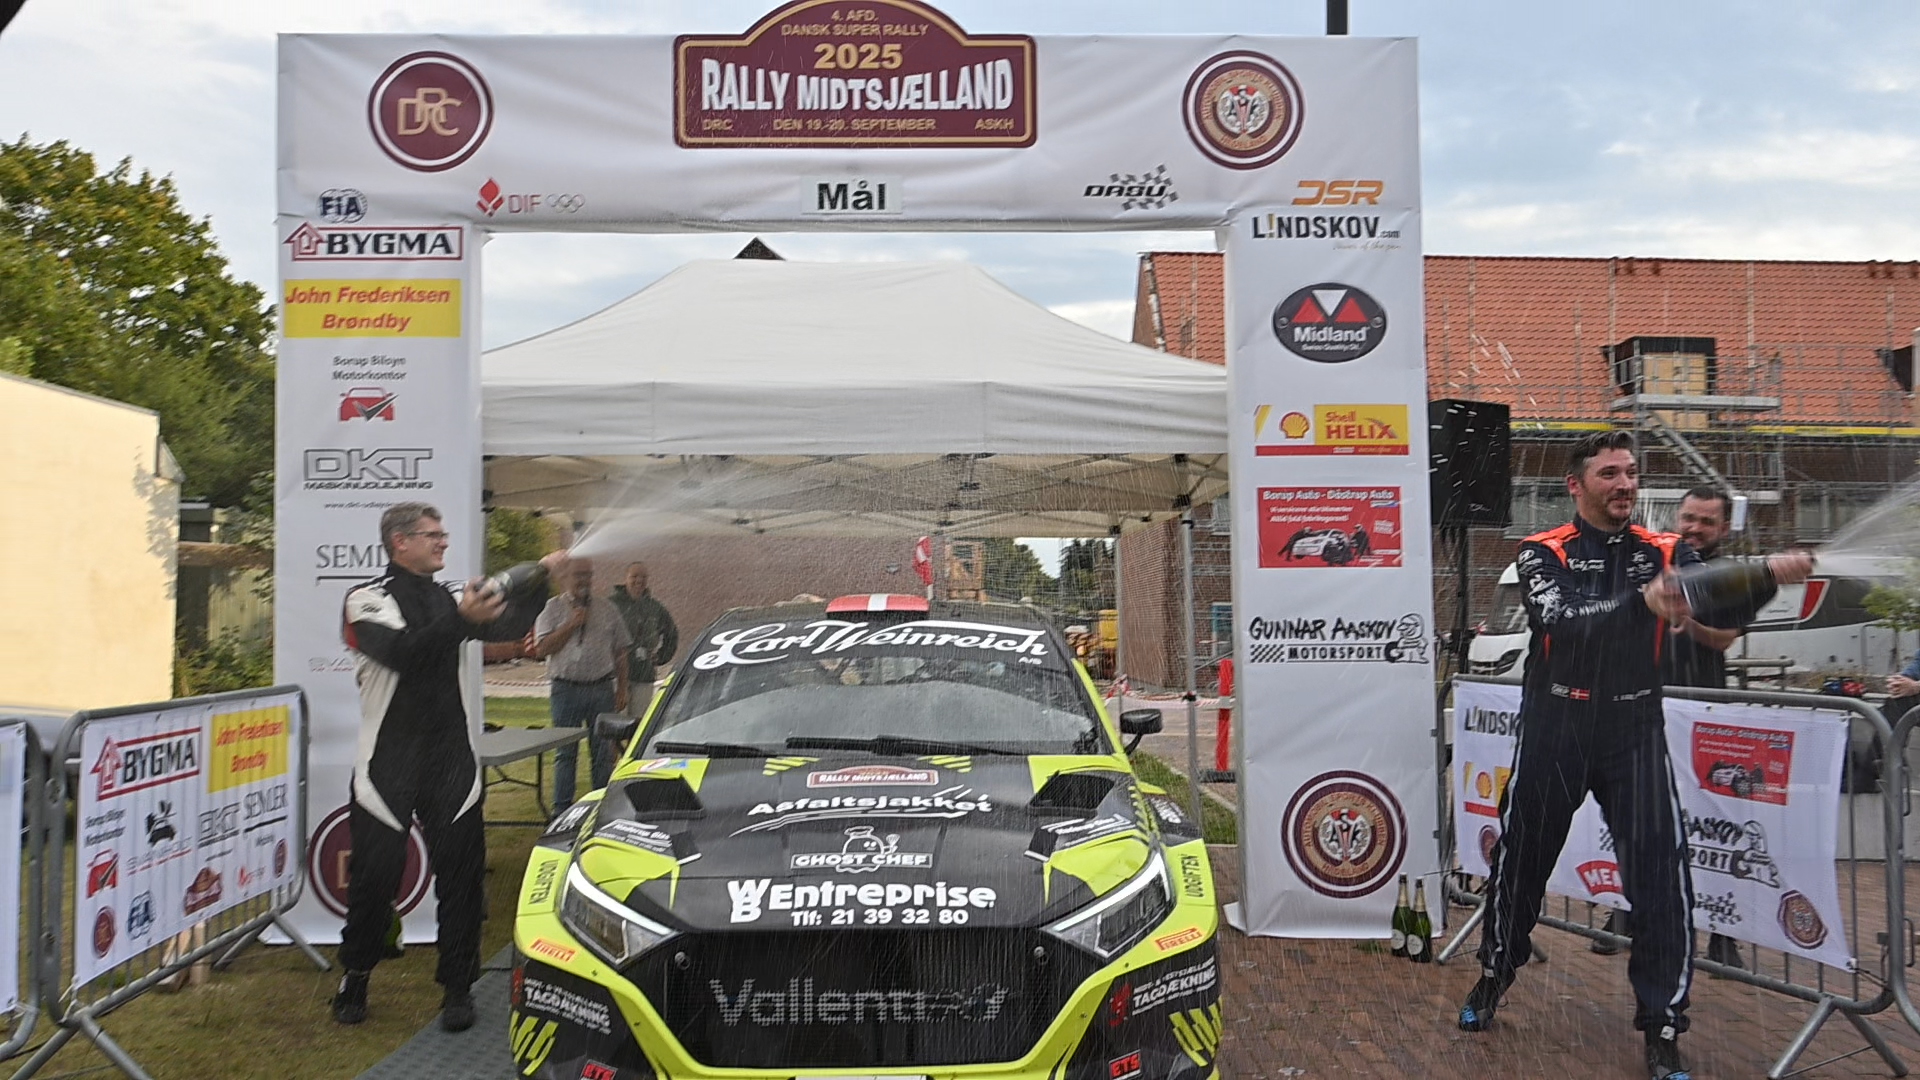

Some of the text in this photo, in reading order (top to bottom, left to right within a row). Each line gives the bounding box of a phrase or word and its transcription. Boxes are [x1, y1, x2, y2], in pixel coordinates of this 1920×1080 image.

[831, 10, 878, 21] 4. AFD.
[781, 24, 929, 36] DANSK SUPER RALLY
[813, 43, 903, 69] 2025
[701, 58, 1014, 111] RALLY MIDTSJÆLLAND
[703, 119, 733, 131] DRC
[773, 119, 802, 131] DEN
[850, 119, 936, 131] SEPTEMBER
[974, 119, 1014, 131] ASKH
[508, 194, 541, 213] DIF
[817, 180, 886, 210] Mål
[320, 196, 360, 216] FIA
[326, 232, 455, 255] BYGMA
[286, 286, 451, 304] John Frederiksen
[322, 313, 411, 332] Brøndby
[1293, 326, 1368, 342] Midland
[1326, 412, 1356, 424] Shell
[1326, 424, 1397, 439] HELIX
[304, 448, 433, 480] DKT
[1249, 616, 1326, 640] GUNNAR
[805, 620, 1048, 656] Weinreich
[1288, 646, 1382, 660] MOTORSPORT
[122, 738, 195, 784] BYGMA
[819, 773, 850, 782] RALLY
[796, 853, 929, 866] GHOST CHEF
[769, 880, 997, 911] Entreprise
[791, 909, 969, 927] Tlf: 21 39 32 80
[1155, 927, 1202, 951] PIRELLI
[1112, 1056, 1140, 1079] ETS
